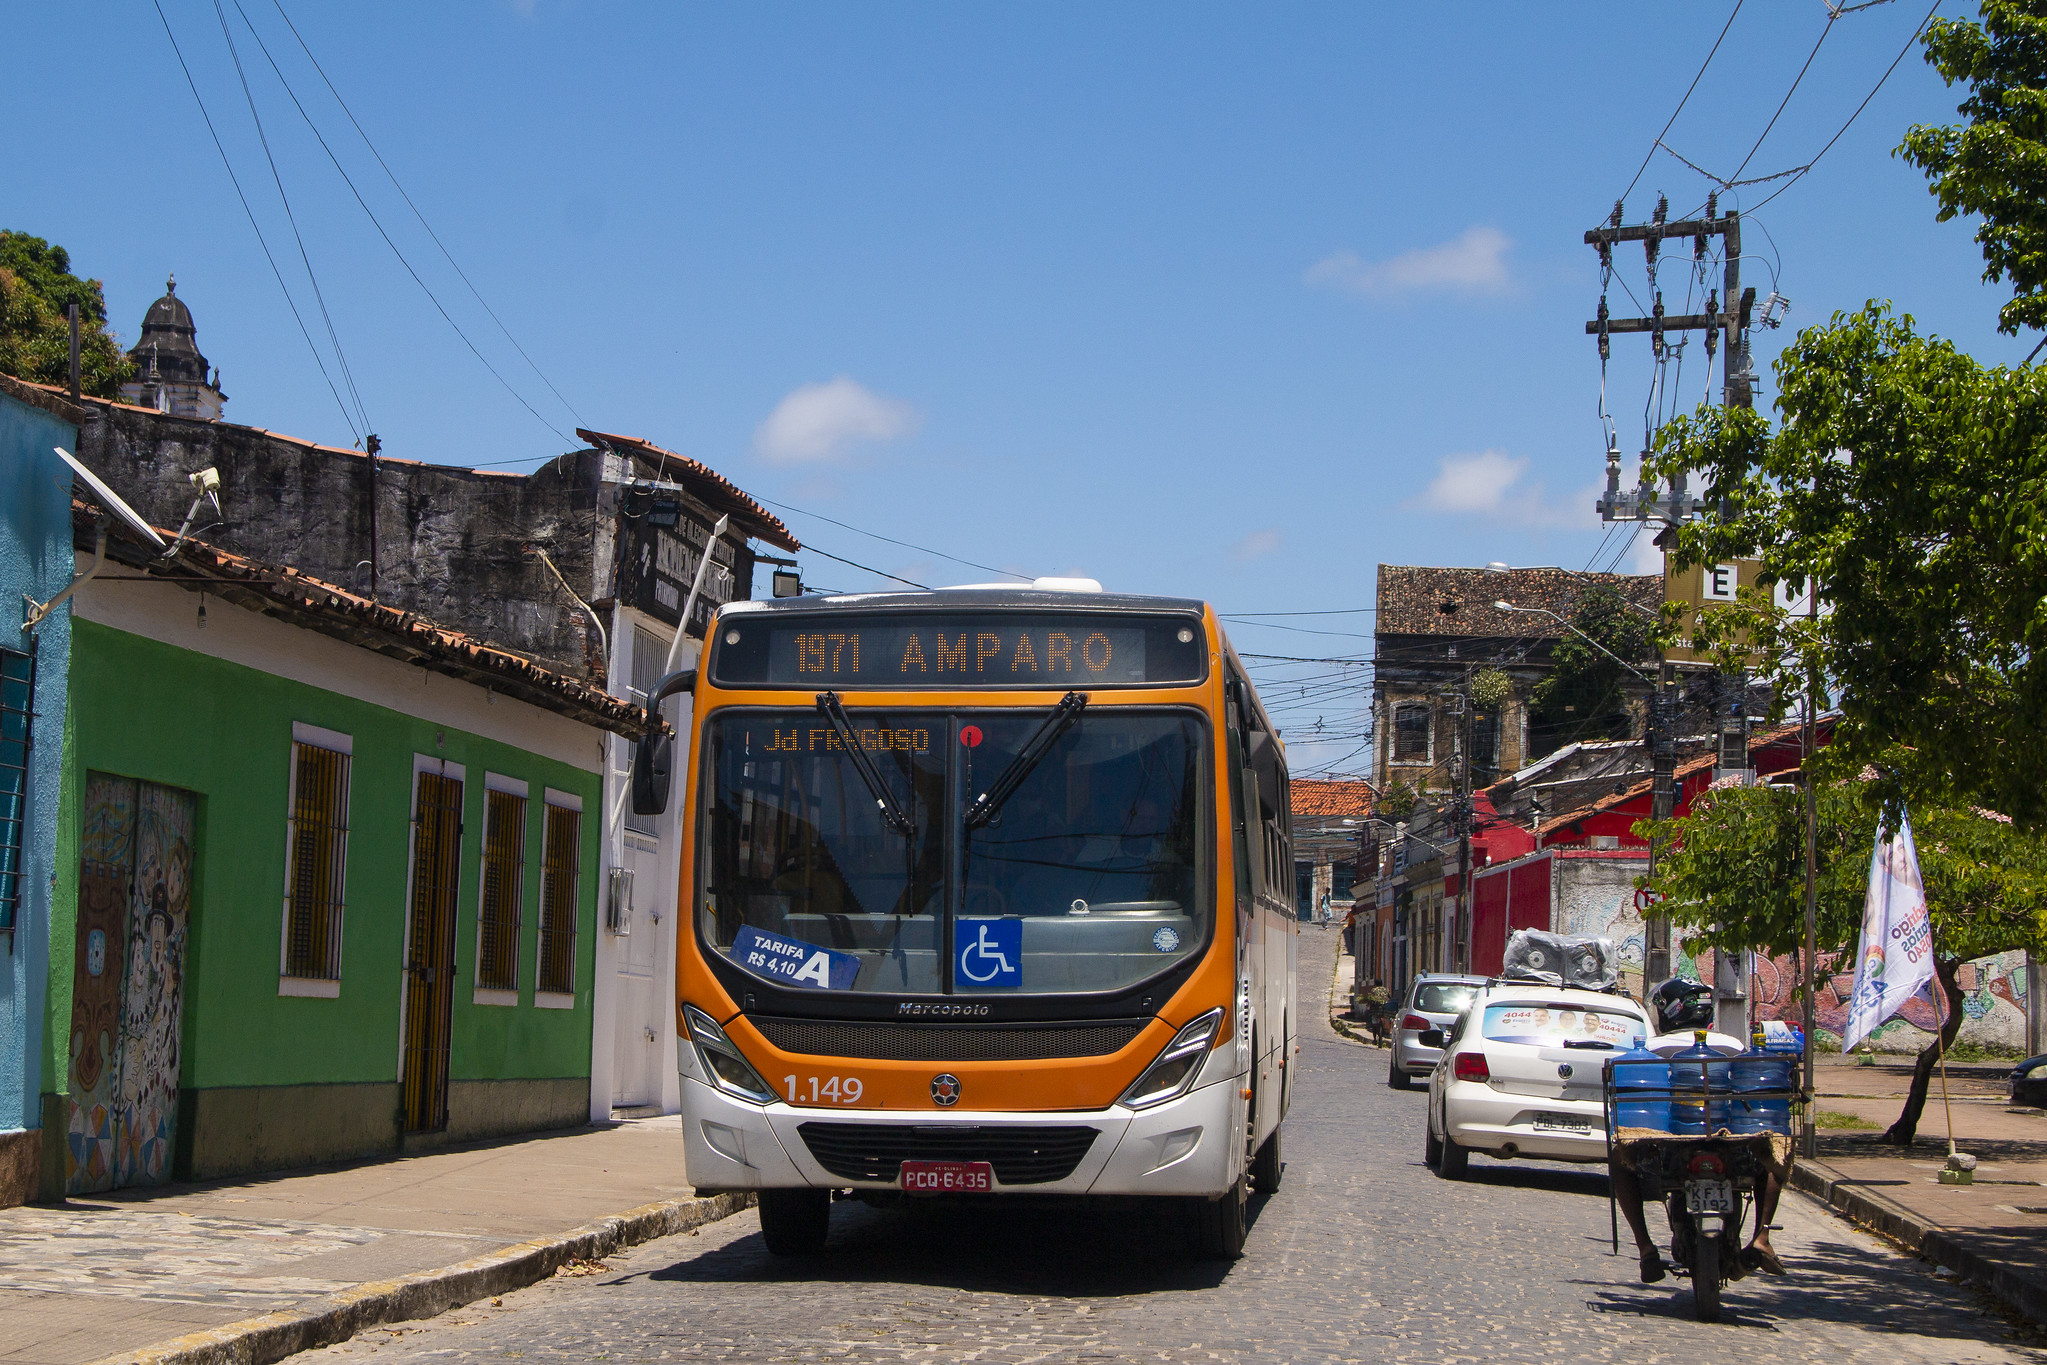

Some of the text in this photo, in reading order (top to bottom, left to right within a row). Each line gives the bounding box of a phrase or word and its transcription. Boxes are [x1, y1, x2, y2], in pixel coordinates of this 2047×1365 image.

[1713, 569, 1729, 595] E
[794, 632, 1112, 672] 1971 AMPARO
[764, 729, 929, 751] Jd. FRAGOSO
[754, 936, 804, 960] TARIFA
[747, 951, 796, 975] R$ 4,10
[792, 951, 830, 989] A
[899, 1003, 989, 1016] Marcopolo
[1600, 1024, 1626, 1034] 40444
[784, 1074, 863, 1103] 1.149
[1692, 1187, 1726, 1199] KFT
[1691, 1200, 1728, 1211] 3192
